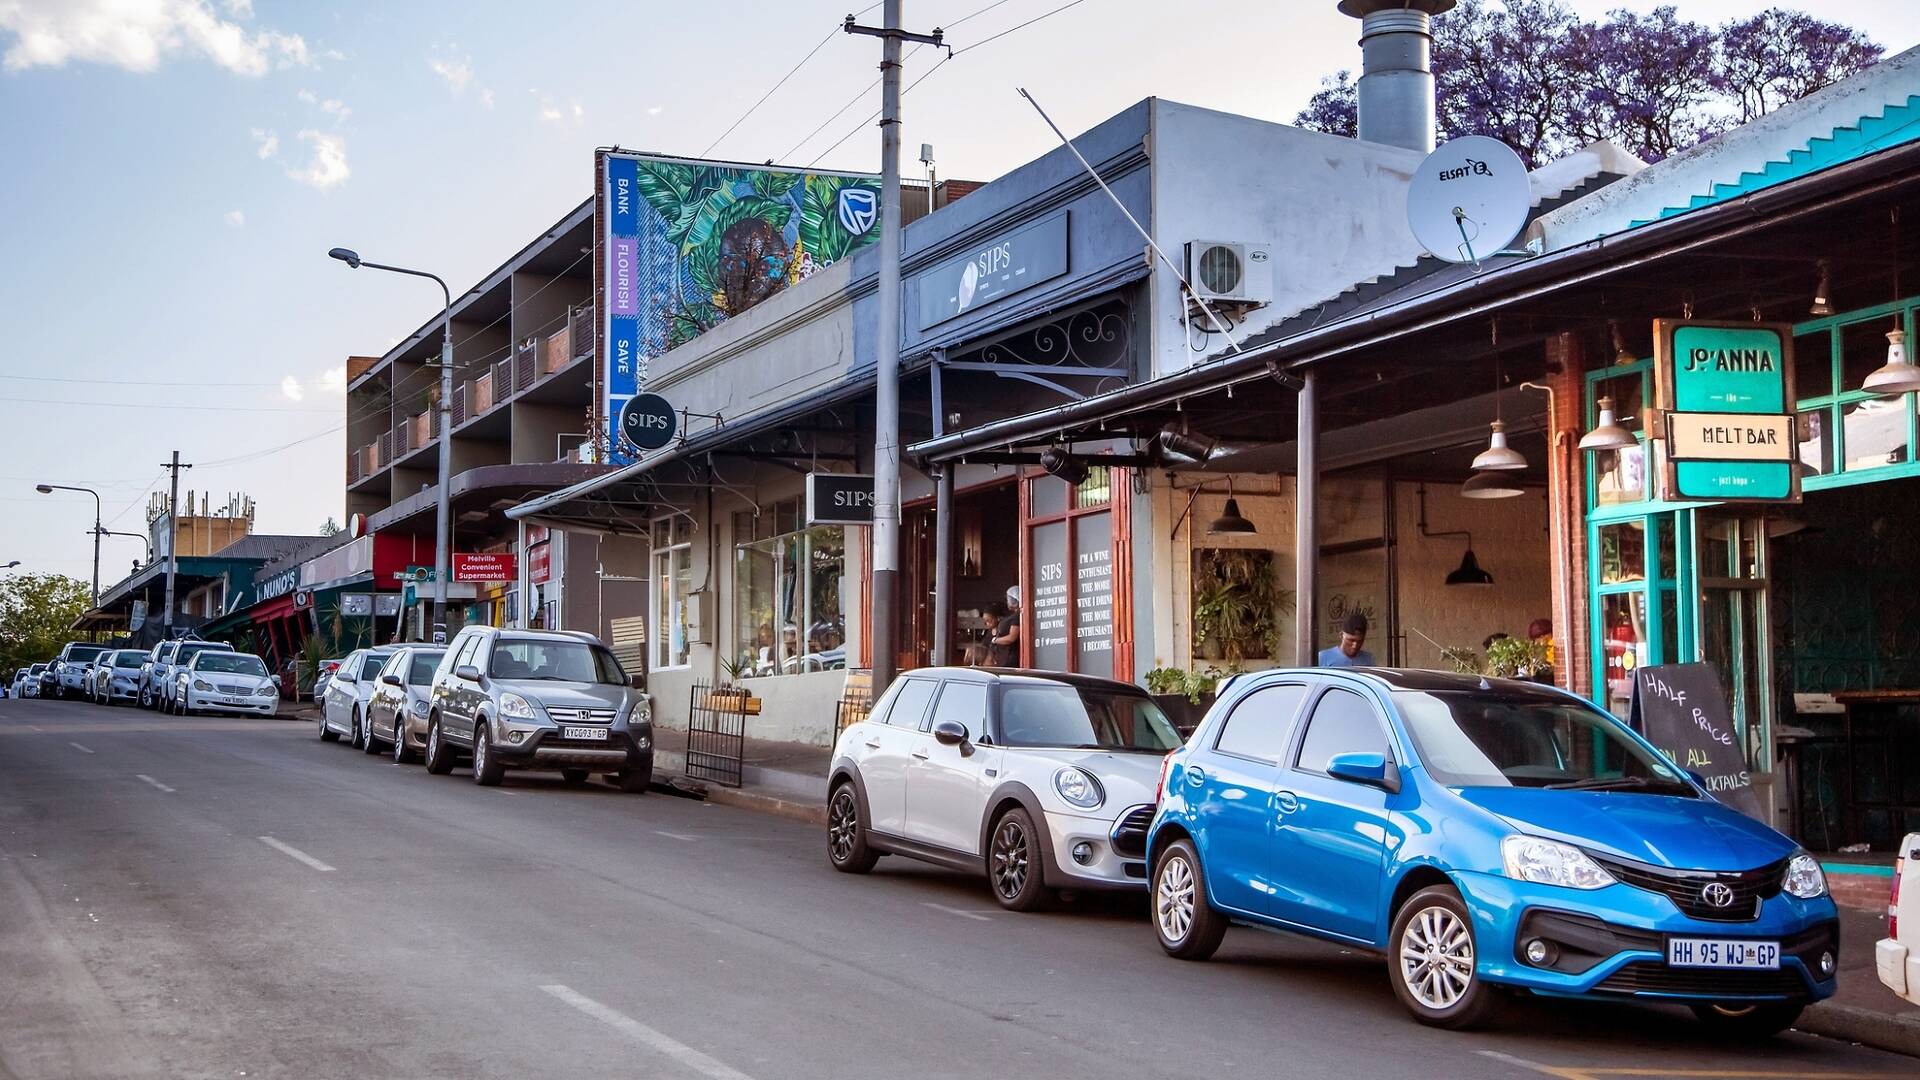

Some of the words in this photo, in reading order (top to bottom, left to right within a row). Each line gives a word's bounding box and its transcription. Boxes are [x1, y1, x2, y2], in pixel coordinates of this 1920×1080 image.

[1439, 166, 1471, 181] ELSAT
[617, 177, 630, 216] BANK
[979, 242, 1011, 278] SIPS
[617, 243, 630, 310] FLOURISH
[617, 339, 630, 375] SAVE
[628, 413, 668, 430] SIPS
[1703, 427, 1742, 444] MELT
[1747, 428, 1777, 445] BAR
[834, 490, 875, 507] SIPS
[1094, 550, 1109, 561] WINE
[458, 572, 506, 580] Supermarket
[461, 563, 503, 571] Convenient
[1041, 562, 1062, 581] SIPS
[263, 571, 296, 599] NUNO'S
[1082, 582, 1093, 593] THE
[1093, 580, 1110, 591] MORE
[1082, 611, 1093, 622] THE
[1094, 609, 1110, 621] MORE
[1644, 673, 1687, 707] HALF
[1692, 708, 1731, 745] PRICE
[1686, 748, 1712, 767] ALL
[1705, 771, 1751, 791] CKTAILS
[1674, 942, 1693, 963] HH
[1700, 943, 1719, 964] 95
[1726, 944, 1744, 965] WJ
[1757, 945, 1776, 966] GP
